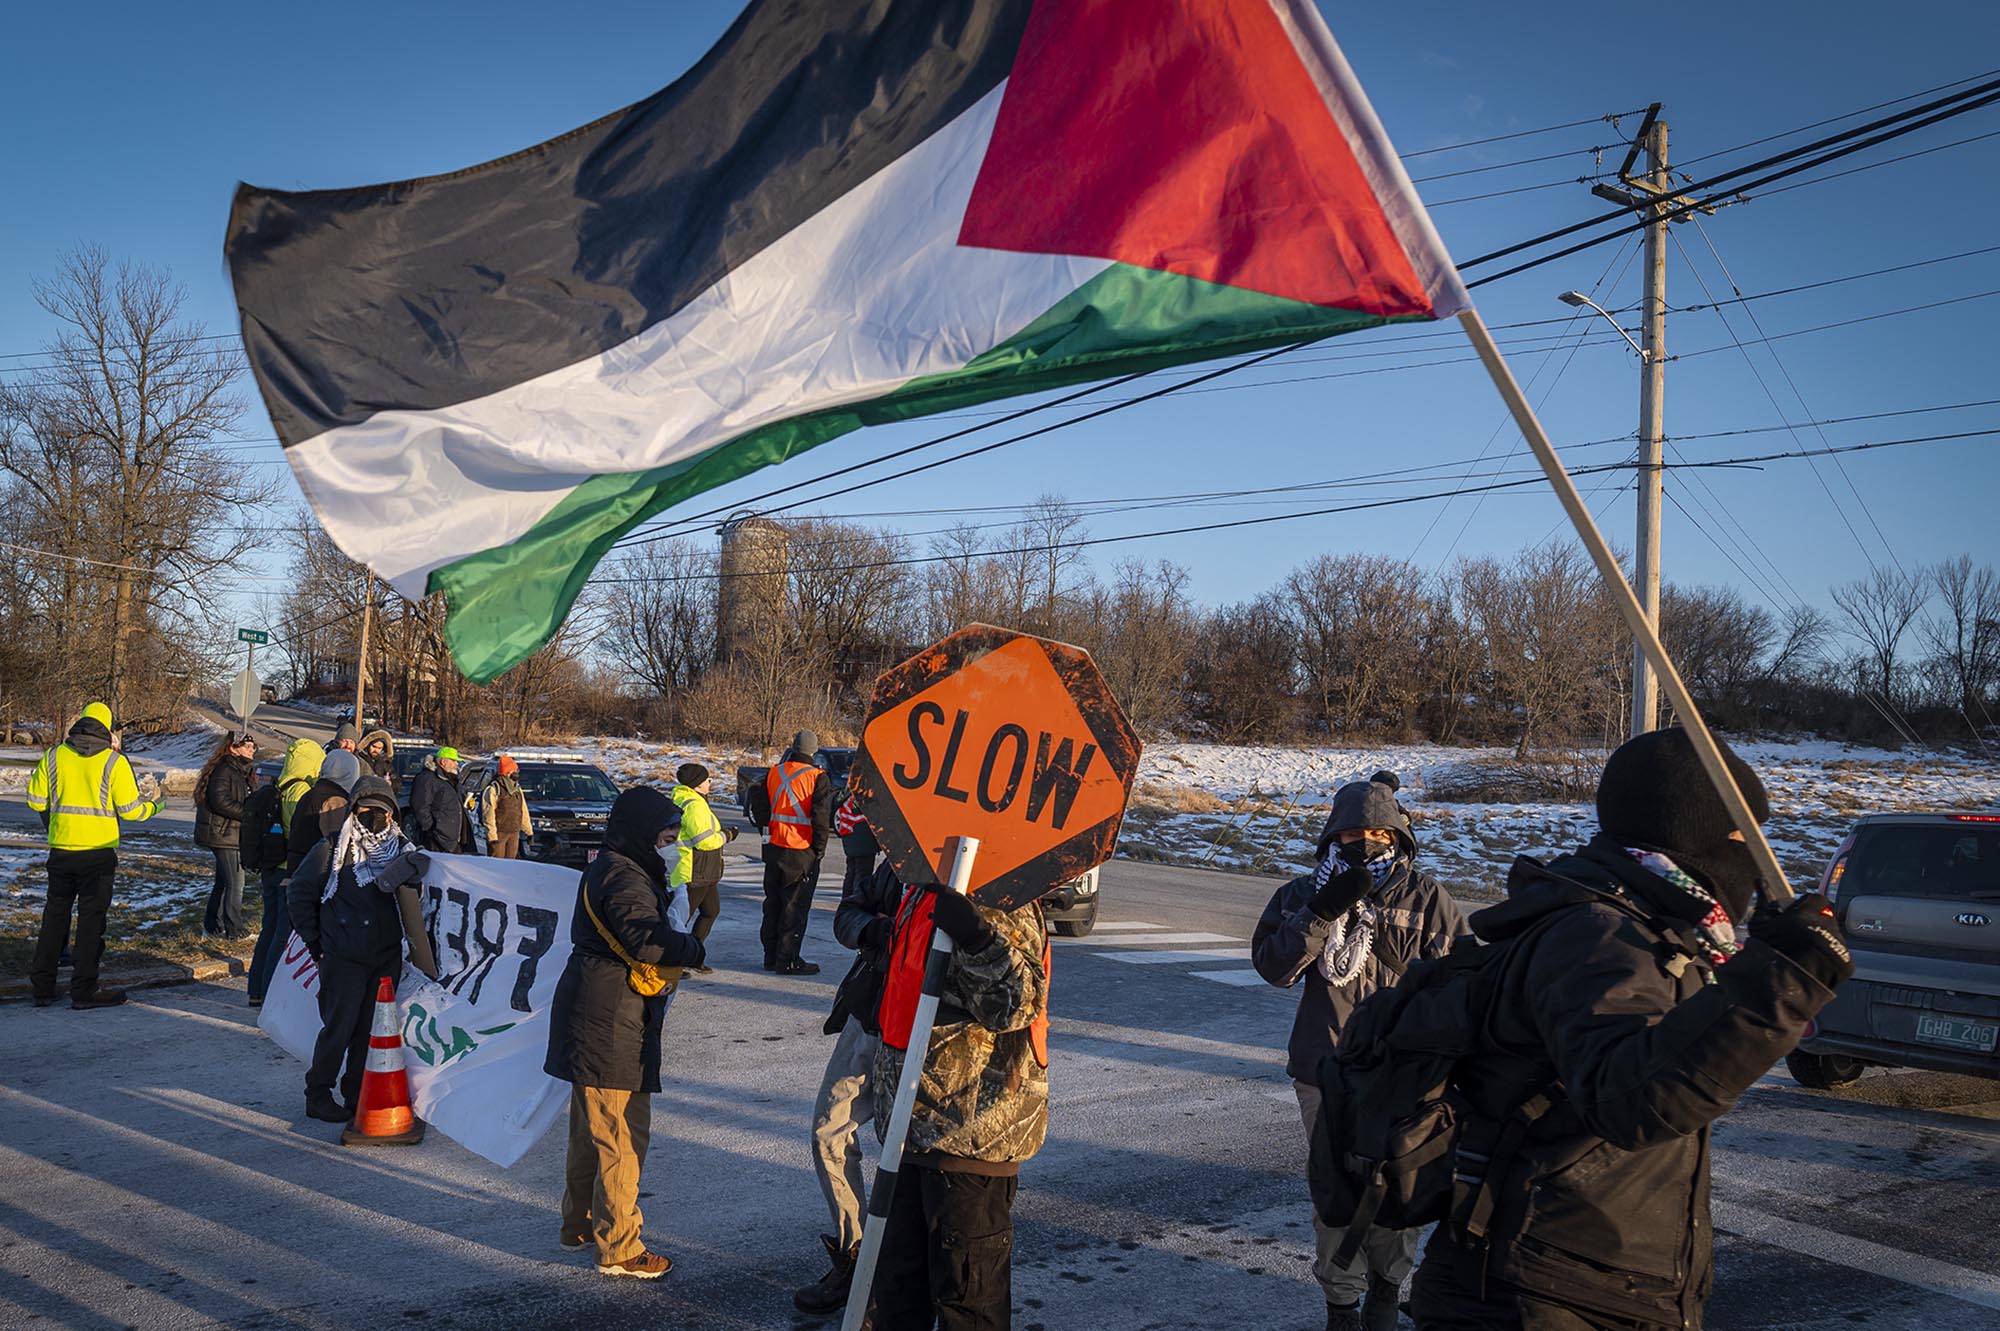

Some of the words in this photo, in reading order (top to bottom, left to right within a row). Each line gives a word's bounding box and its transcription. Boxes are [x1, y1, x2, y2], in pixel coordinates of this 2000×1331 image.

[242, 631, 257, 641] West
[892, 701, 1098, 830] SLOW
[1958, 914, 1985, 925] KIA
[1924, 1019, 1953, 1037] GHB
[1960, 1024, 1991, 1042] 206
